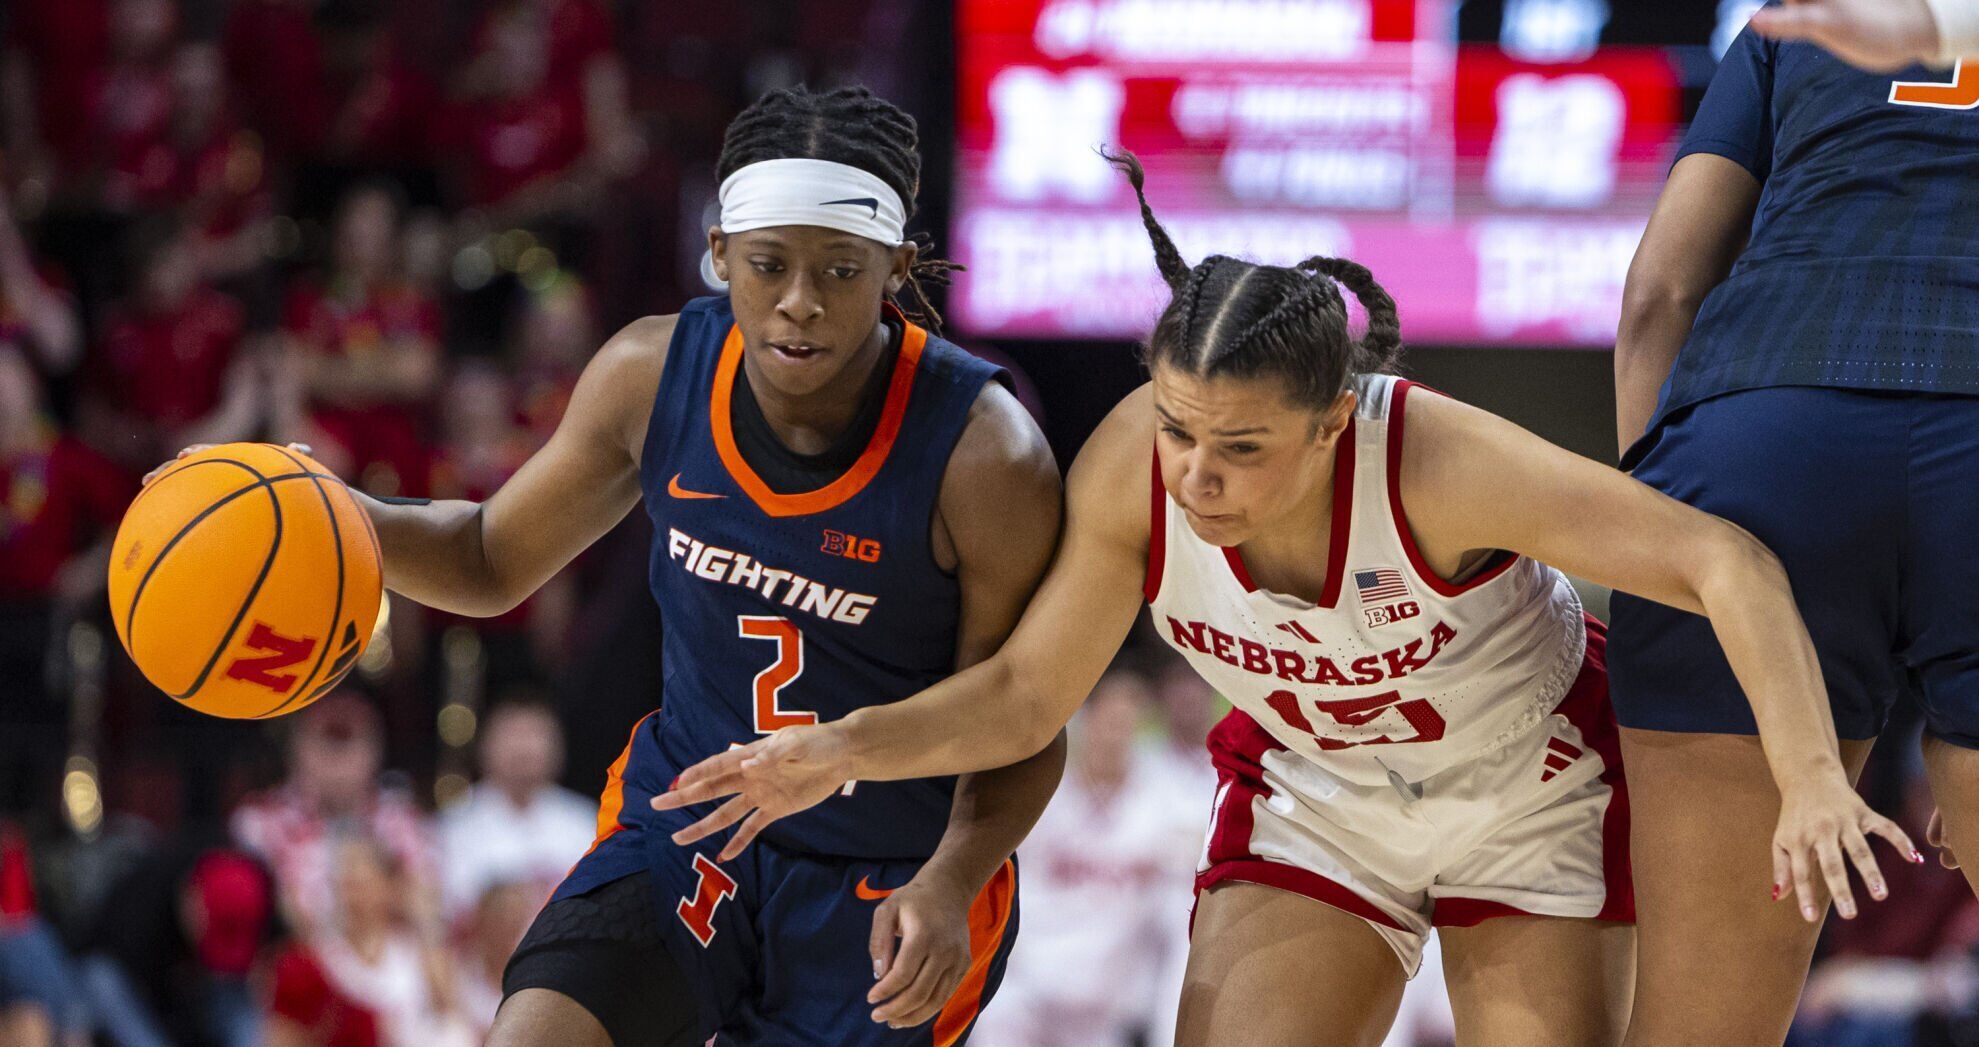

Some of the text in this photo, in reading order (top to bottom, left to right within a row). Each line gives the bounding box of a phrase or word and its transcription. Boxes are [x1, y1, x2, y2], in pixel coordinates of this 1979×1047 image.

[668, 527, 878, 625] FIGHTING
[225, 620, 317, 694] N
[737, 614, 818, 734] 2
[1166, 614, 1457, 686] NEBRASKA
[1263, 689, 1447, 751] 15
